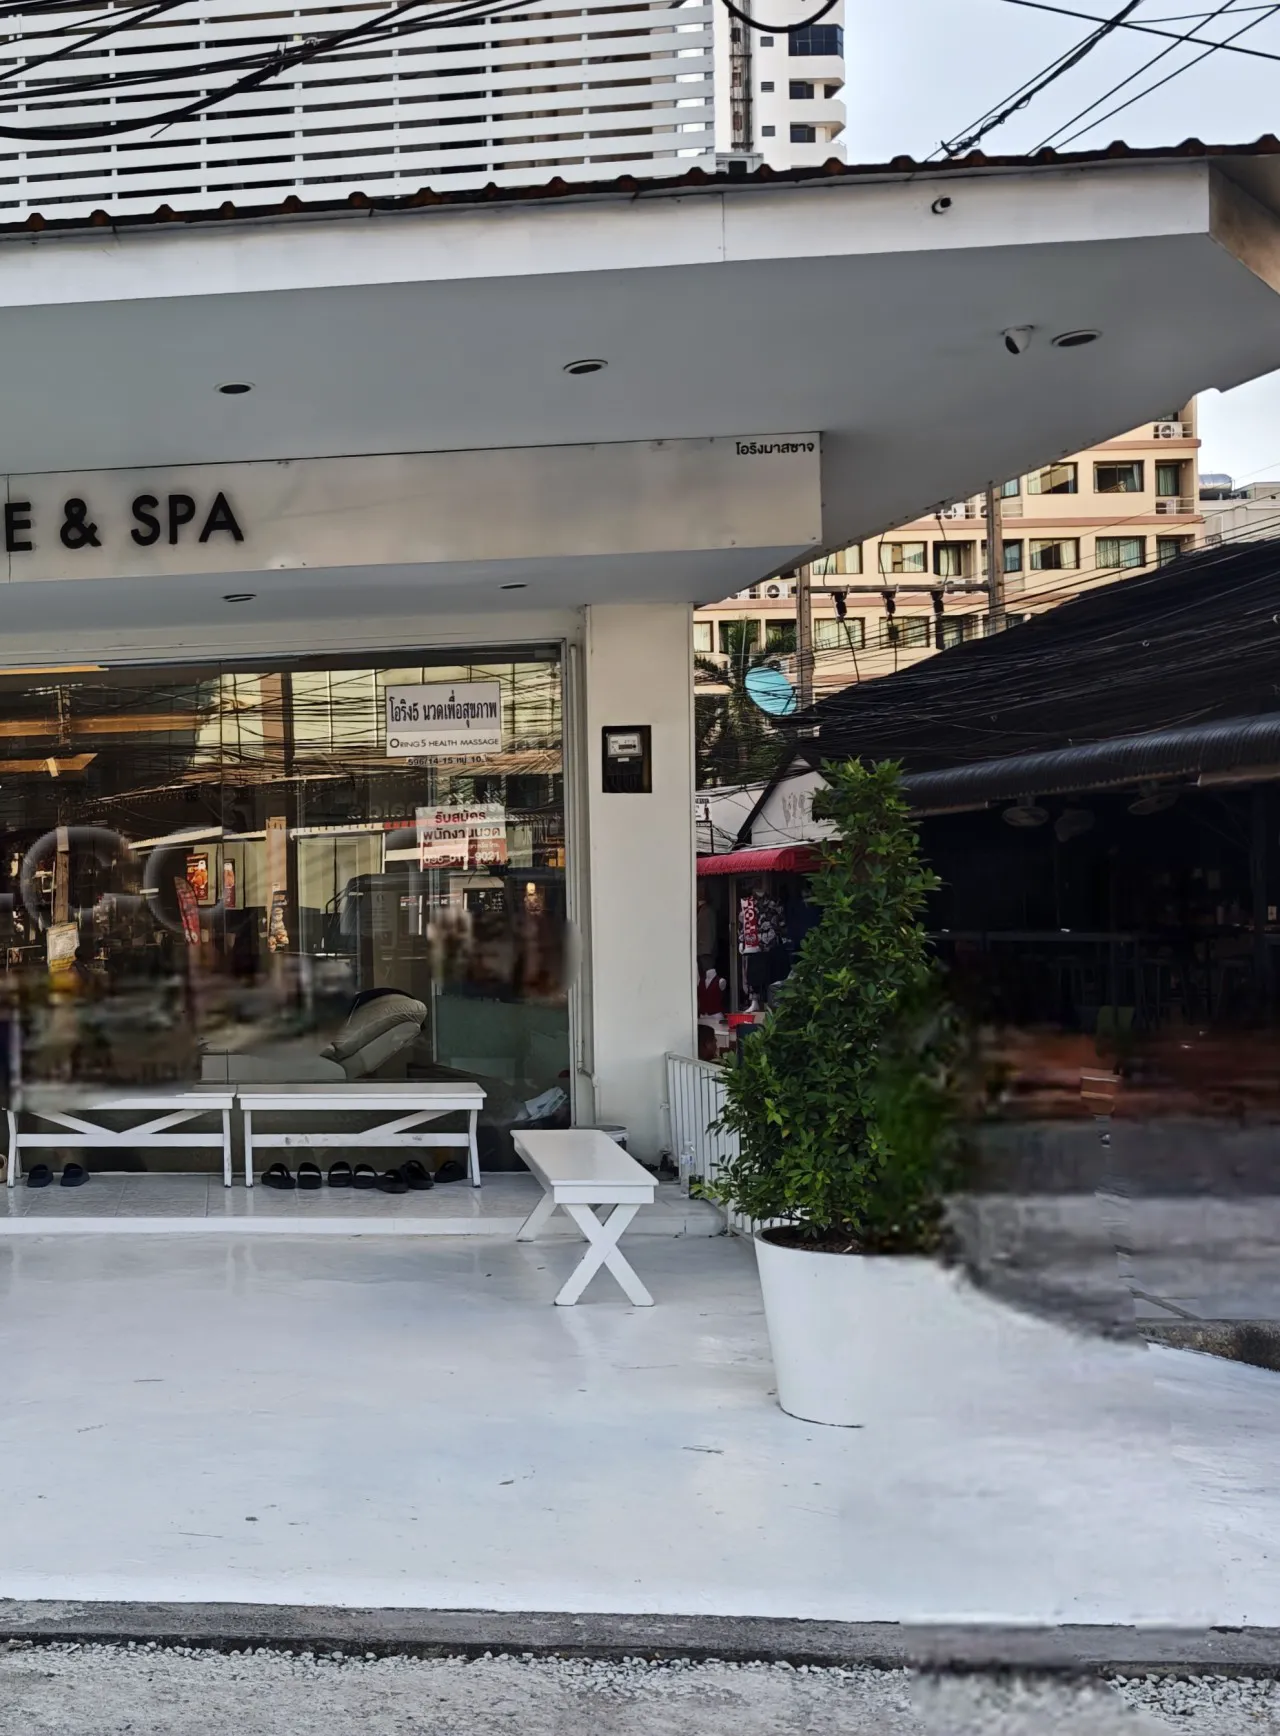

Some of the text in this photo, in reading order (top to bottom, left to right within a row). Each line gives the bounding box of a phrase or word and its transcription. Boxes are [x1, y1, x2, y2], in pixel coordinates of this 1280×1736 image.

[59, 497, 102, 549] &
[130, 491, 245, 547] SPA
[429, 739, 457, 747] HEALTH
[460, 738, 499, 746] MASSAGE
